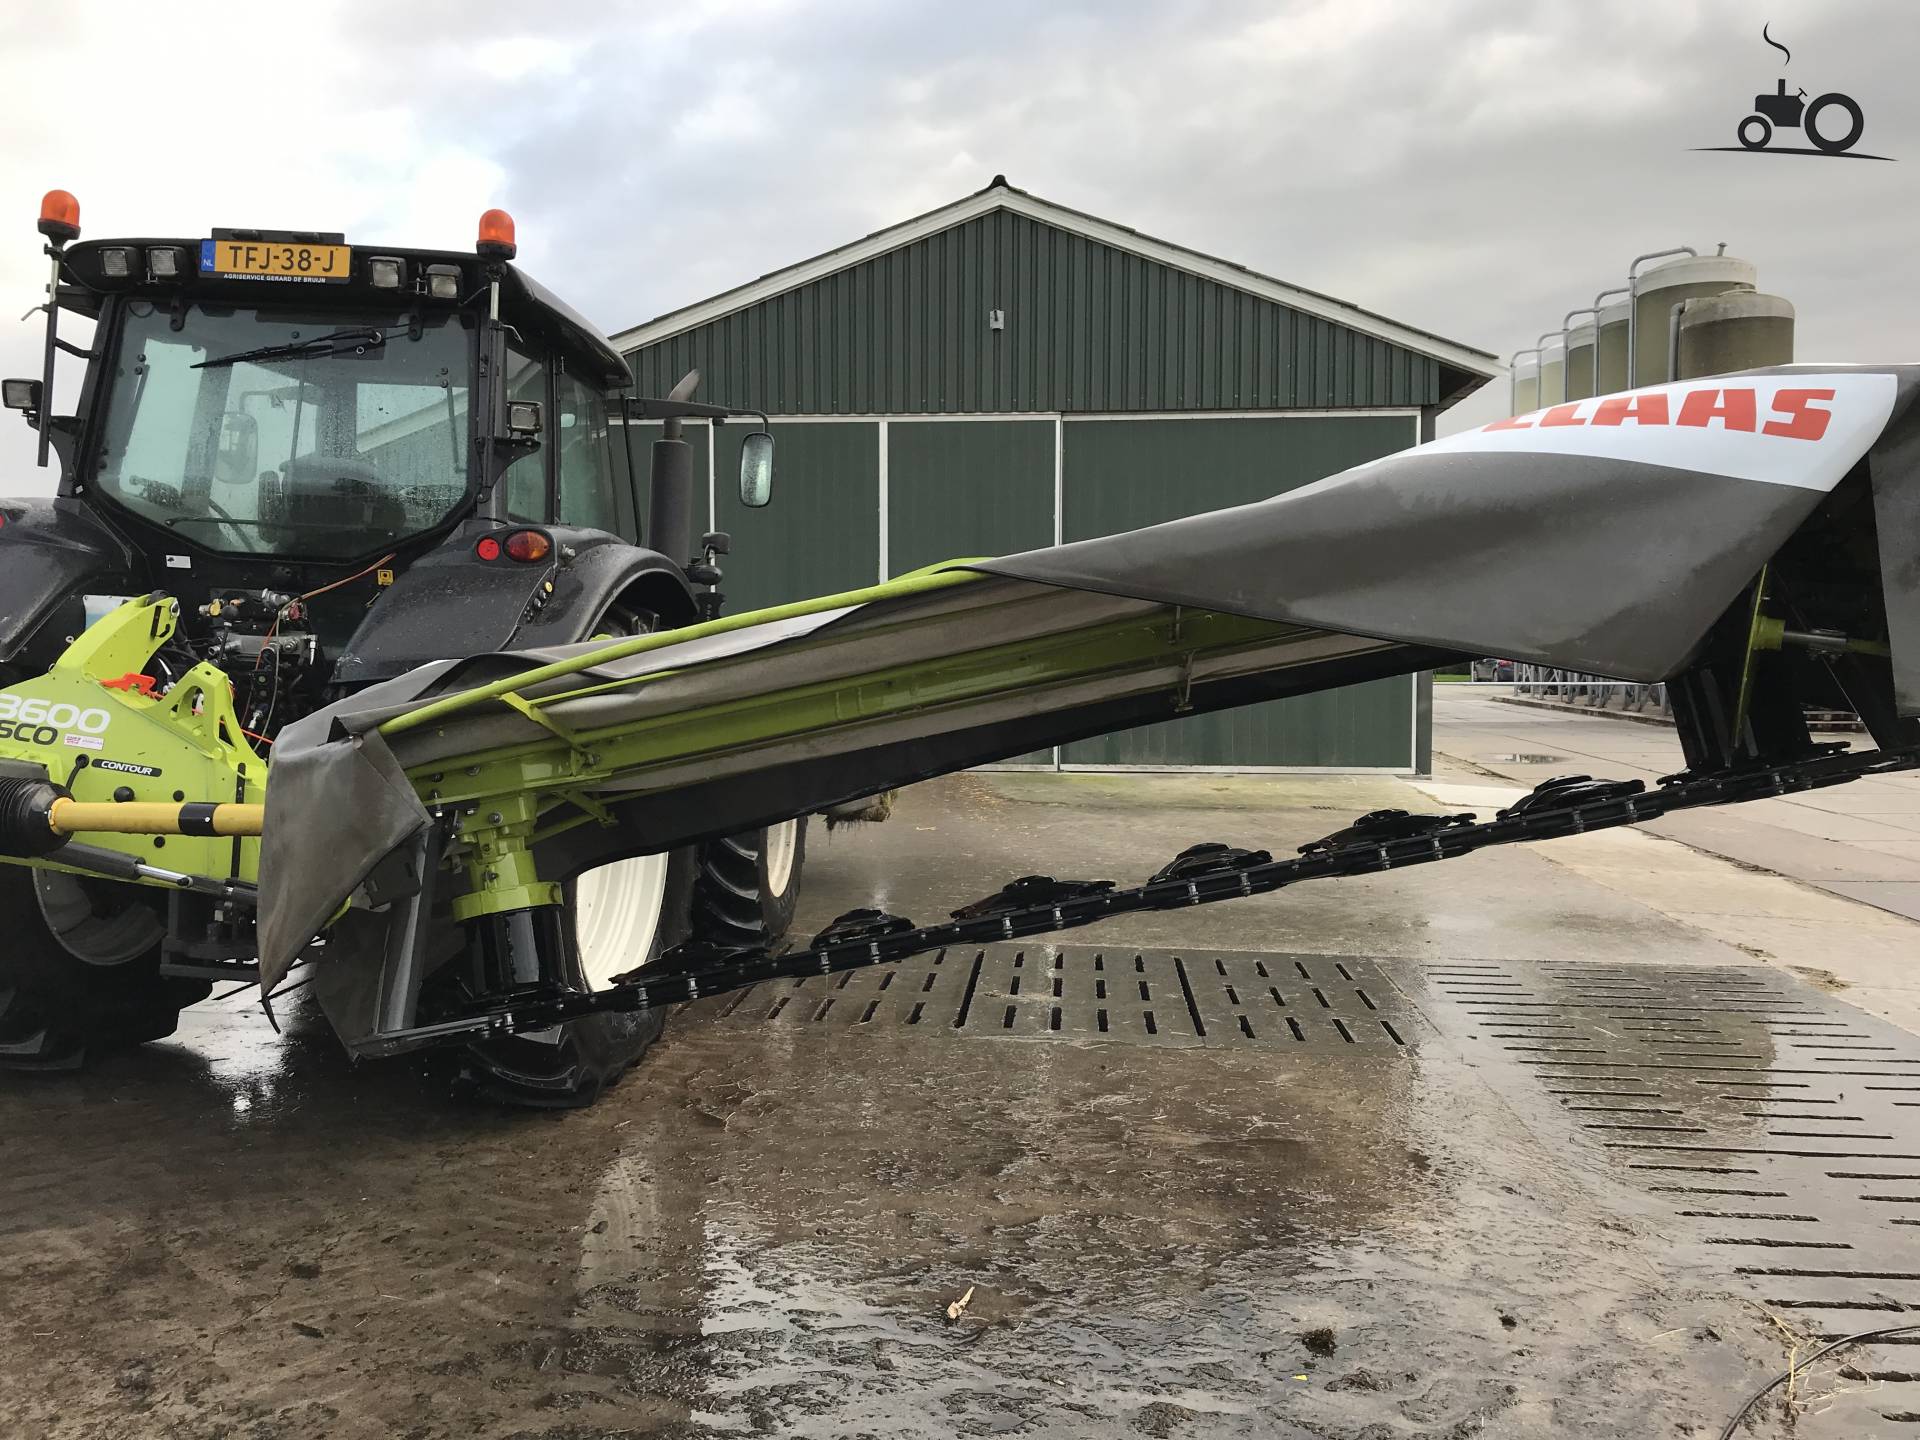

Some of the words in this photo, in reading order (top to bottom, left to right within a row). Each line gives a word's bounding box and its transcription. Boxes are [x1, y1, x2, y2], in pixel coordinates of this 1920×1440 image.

[203, 259, 213, 267] NL
[229, 245, 334, 272] TFJ-38-J
[223, 273, 265, 281] AGRISERVICE
[266, 275, 292, 283] GERARD
[101, 760, 153, 775] CONTOUR
